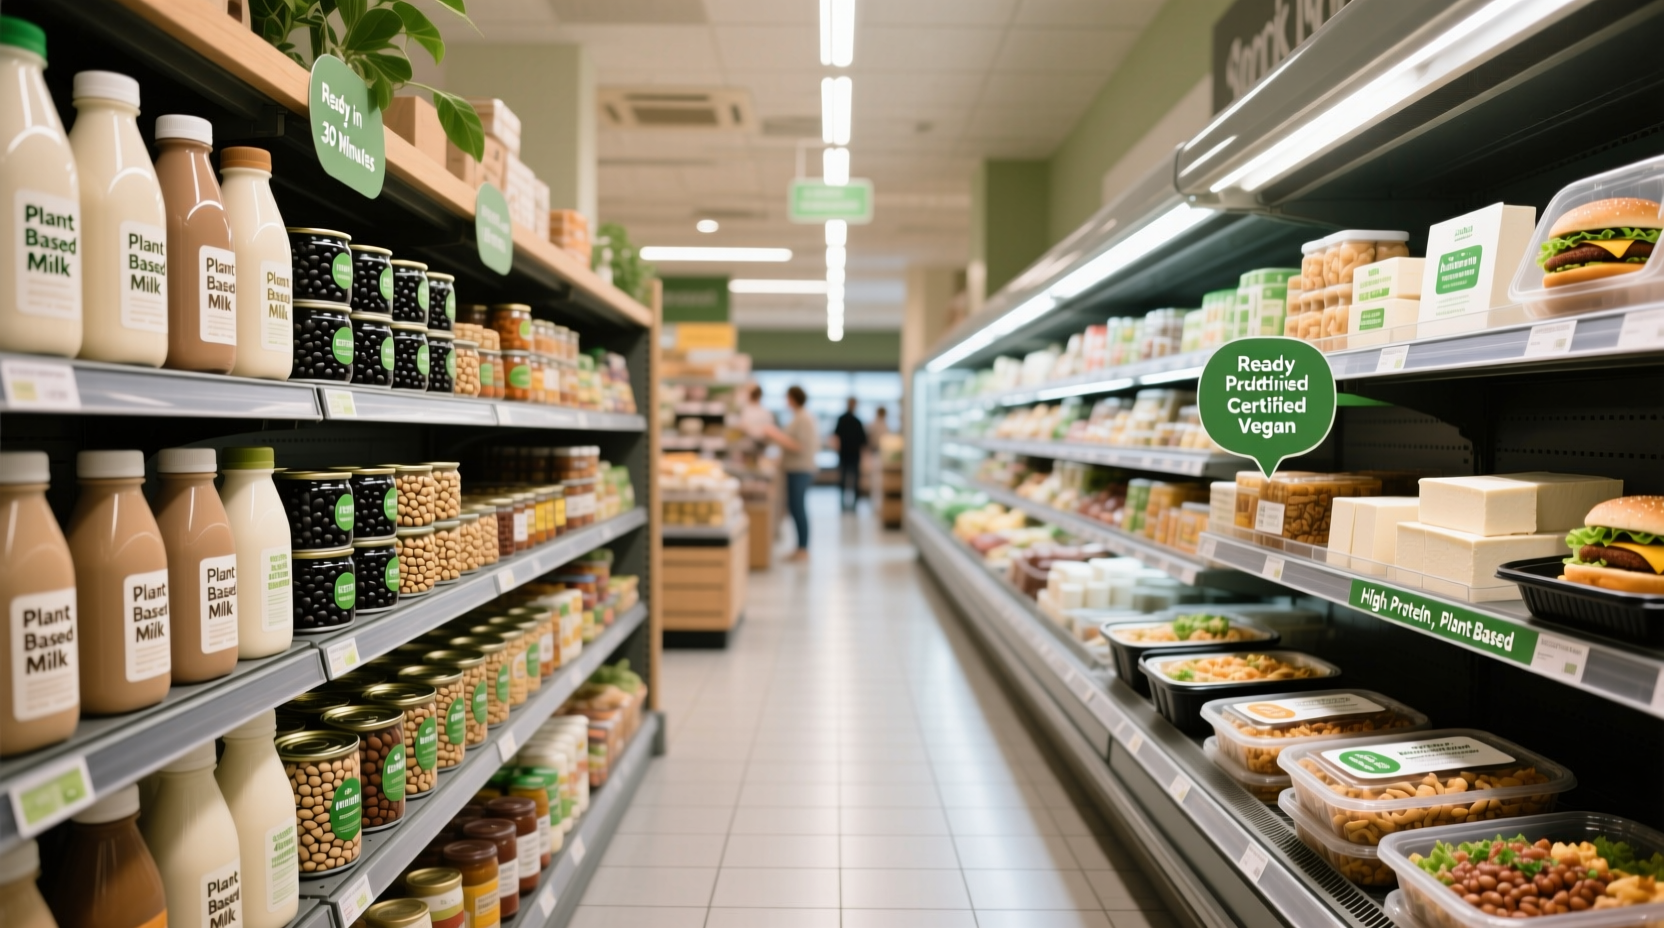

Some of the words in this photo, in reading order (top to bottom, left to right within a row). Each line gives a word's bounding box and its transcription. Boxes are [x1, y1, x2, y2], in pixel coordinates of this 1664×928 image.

[353, 104, 363, 129] in
[321, 121, 337, 147] 30
[25, 204, 75, 231] Plant
[25, 228, 77, 256] Based
[128, 233, 165, 256] Plant
[27, 252, 71, 278] Milk
[128, 254, 166, 276] Based
[206, 257, 235, 276] Plant
[131, 274, 162, 295] Milk
[1238, 354, 1295, 377] Ready
[1238, 417, 1296, 439] Vegan
[207, 566, 235, 584] Plant
[132, 583, 167, 602] Plant
[23, 605, 71, 628] Plant
[1361, 587, 1387, 612] High
[1440, 611, 1472, 637] Plant
[1473, 621, 1515, 652] Based
[24, 623, 73, 651] Based
[135, 621, 165, 643] Milk
[26, 648, 69, 675] Milk
[207, 870, 239, 898] Plant
